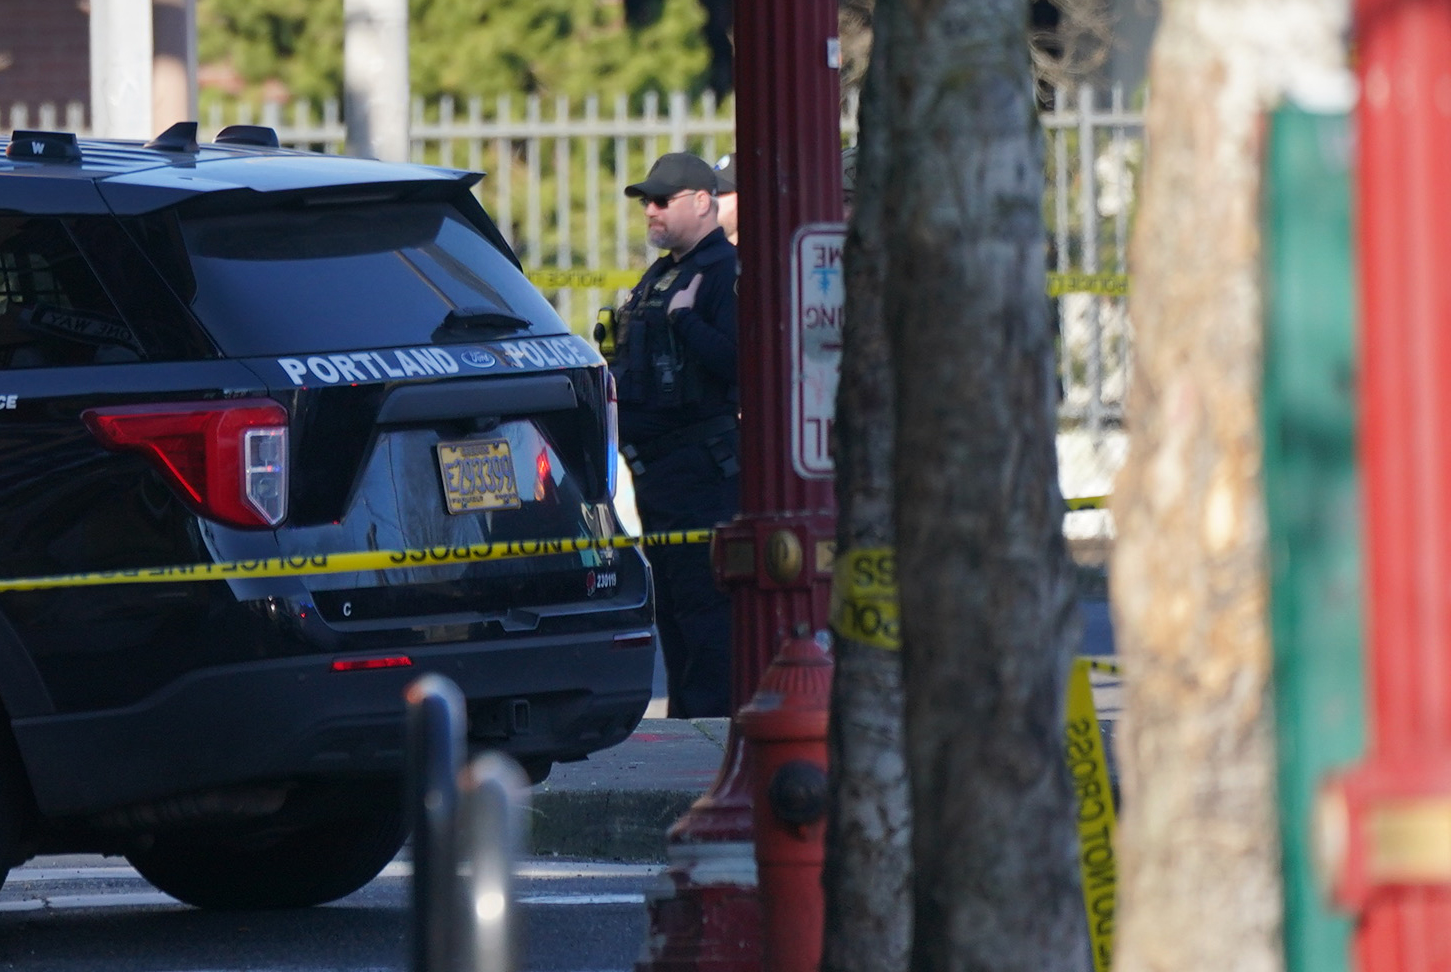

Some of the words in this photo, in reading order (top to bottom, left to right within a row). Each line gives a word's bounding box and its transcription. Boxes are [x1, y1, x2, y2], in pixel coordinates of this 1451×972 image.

[31, 141, 45, 155] W
[504, 338, 587, 369] POLICE
[278, 346, 460, 386] PORTLAND
[343, 602, 351, 616] C
